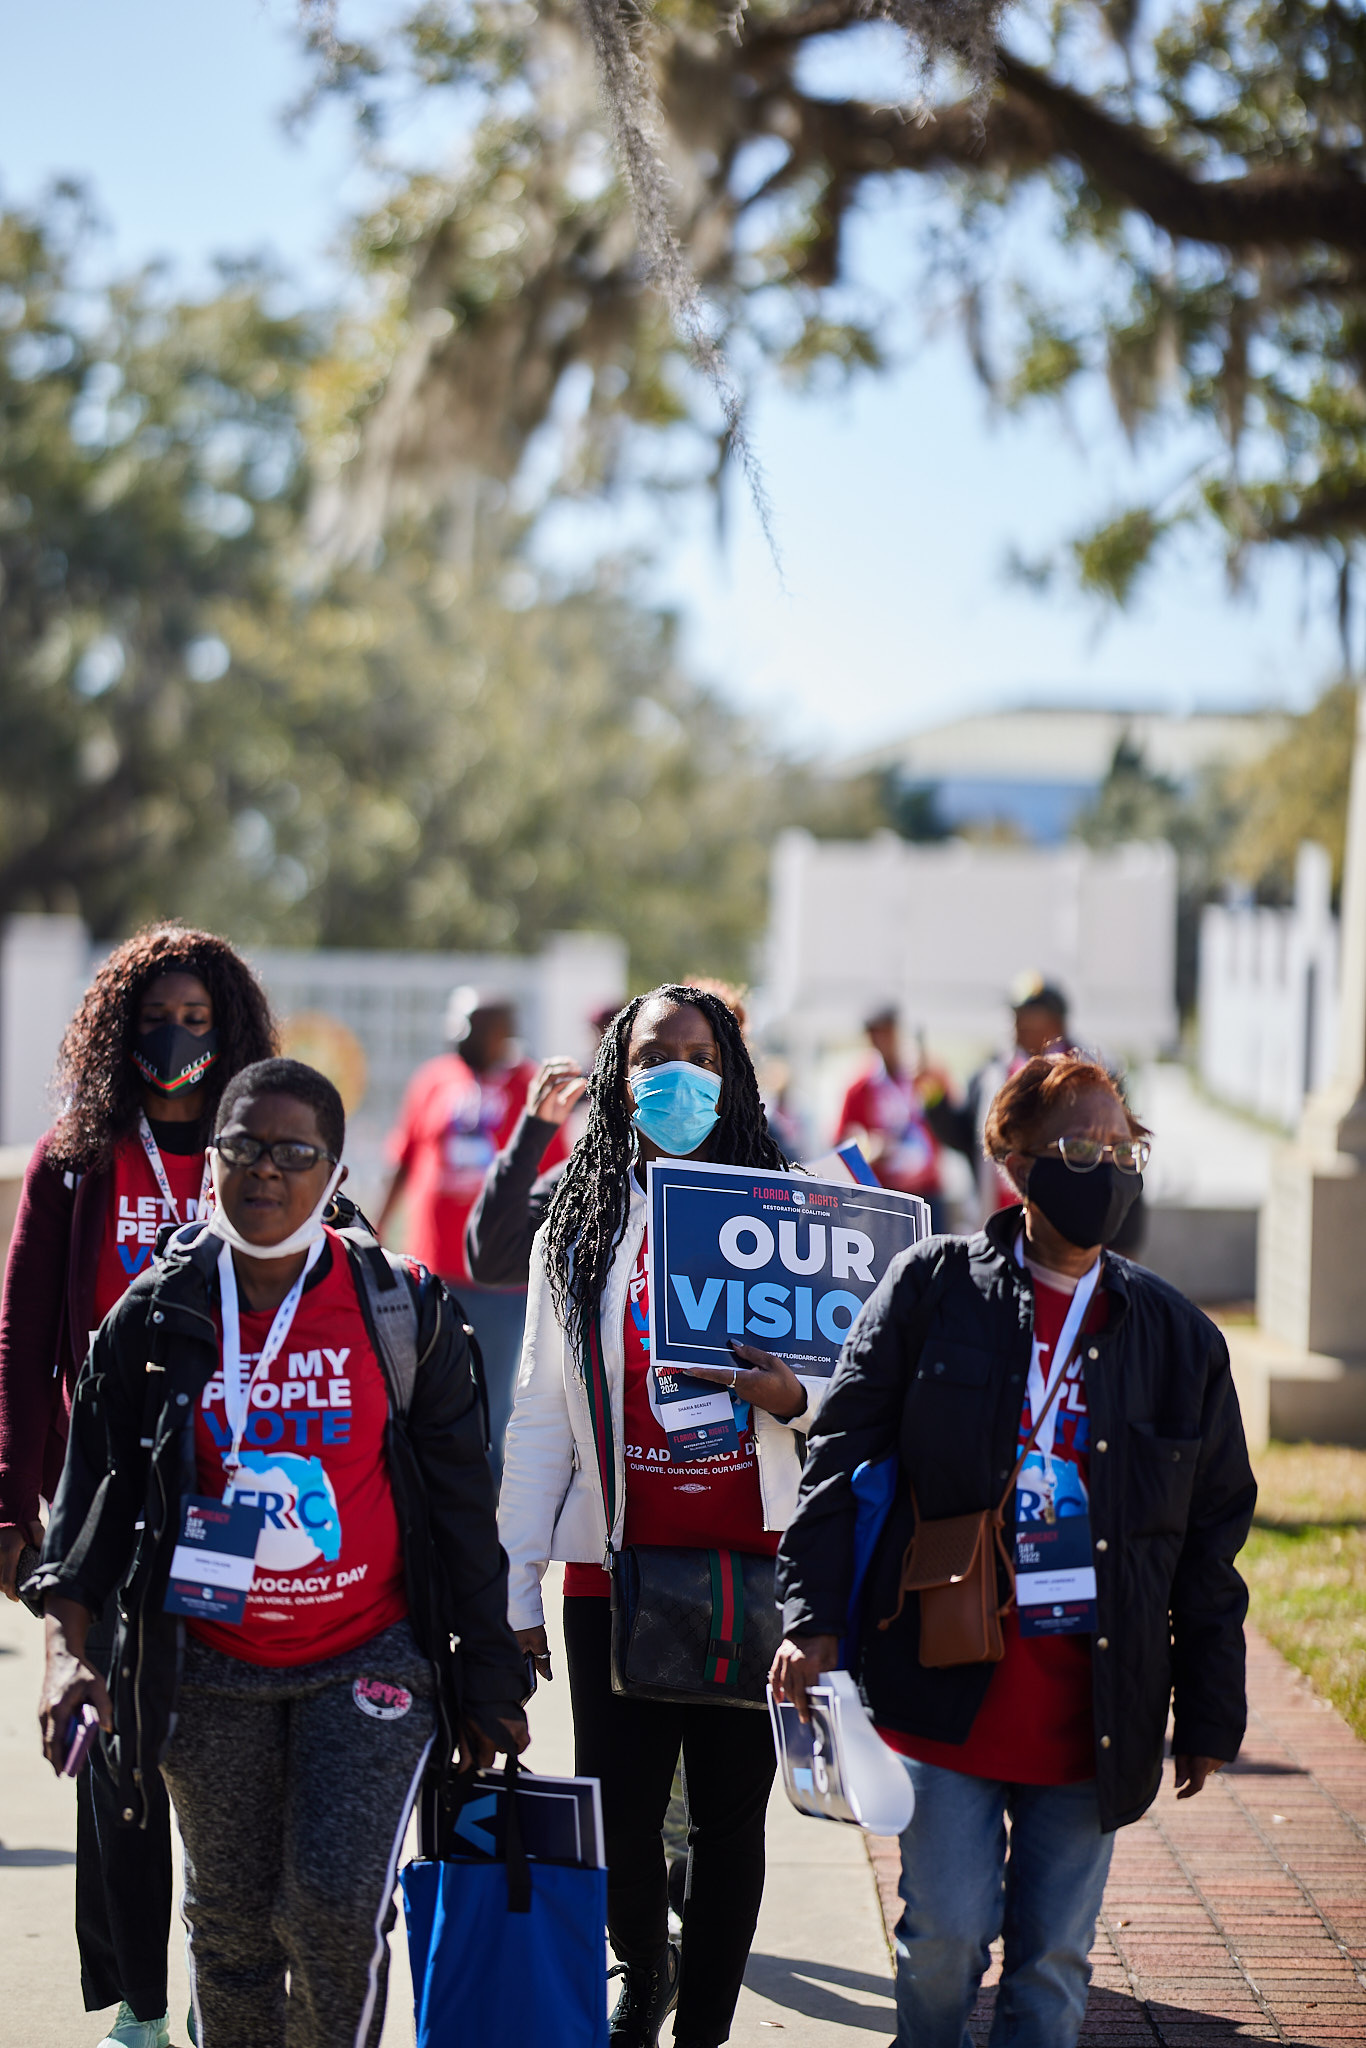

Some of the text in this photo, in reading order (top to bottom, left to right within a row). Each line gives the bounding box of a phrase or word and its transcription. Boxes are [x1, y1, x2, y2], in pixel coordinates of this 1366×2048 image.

[119, 1196, 177, 1220] LET
[753, 1187, 790, 1202] FLORIDA
[809, 1193, 839, 1208] RIGHTS
[763, 1204, 831, 1217] RESTORATION COALITION
[718, 1215, 876, 1283] OUR
[670, 1274, 863, 1346] VISIO
[213, 1348, 350, 1380] ET MY
[657, 1367, 685, 1377] ADVOCA
[658, 1375, 673, 1386] DAY
[661, 1383, 679, 1395] 2022
[202, 1379, 352, 1409] POPLE
[202, 1410, 352, 1447] VOTE
[673, 1425, 729, 1443] FLORIDA RIGHTS
[667, 1467, 685, 1475] OUR
[712, 1465, 729, 1474] OUR
[729, 1461, 753, 1473] VISION
[251, 1564, 368, 1593] VOCACY DAY
